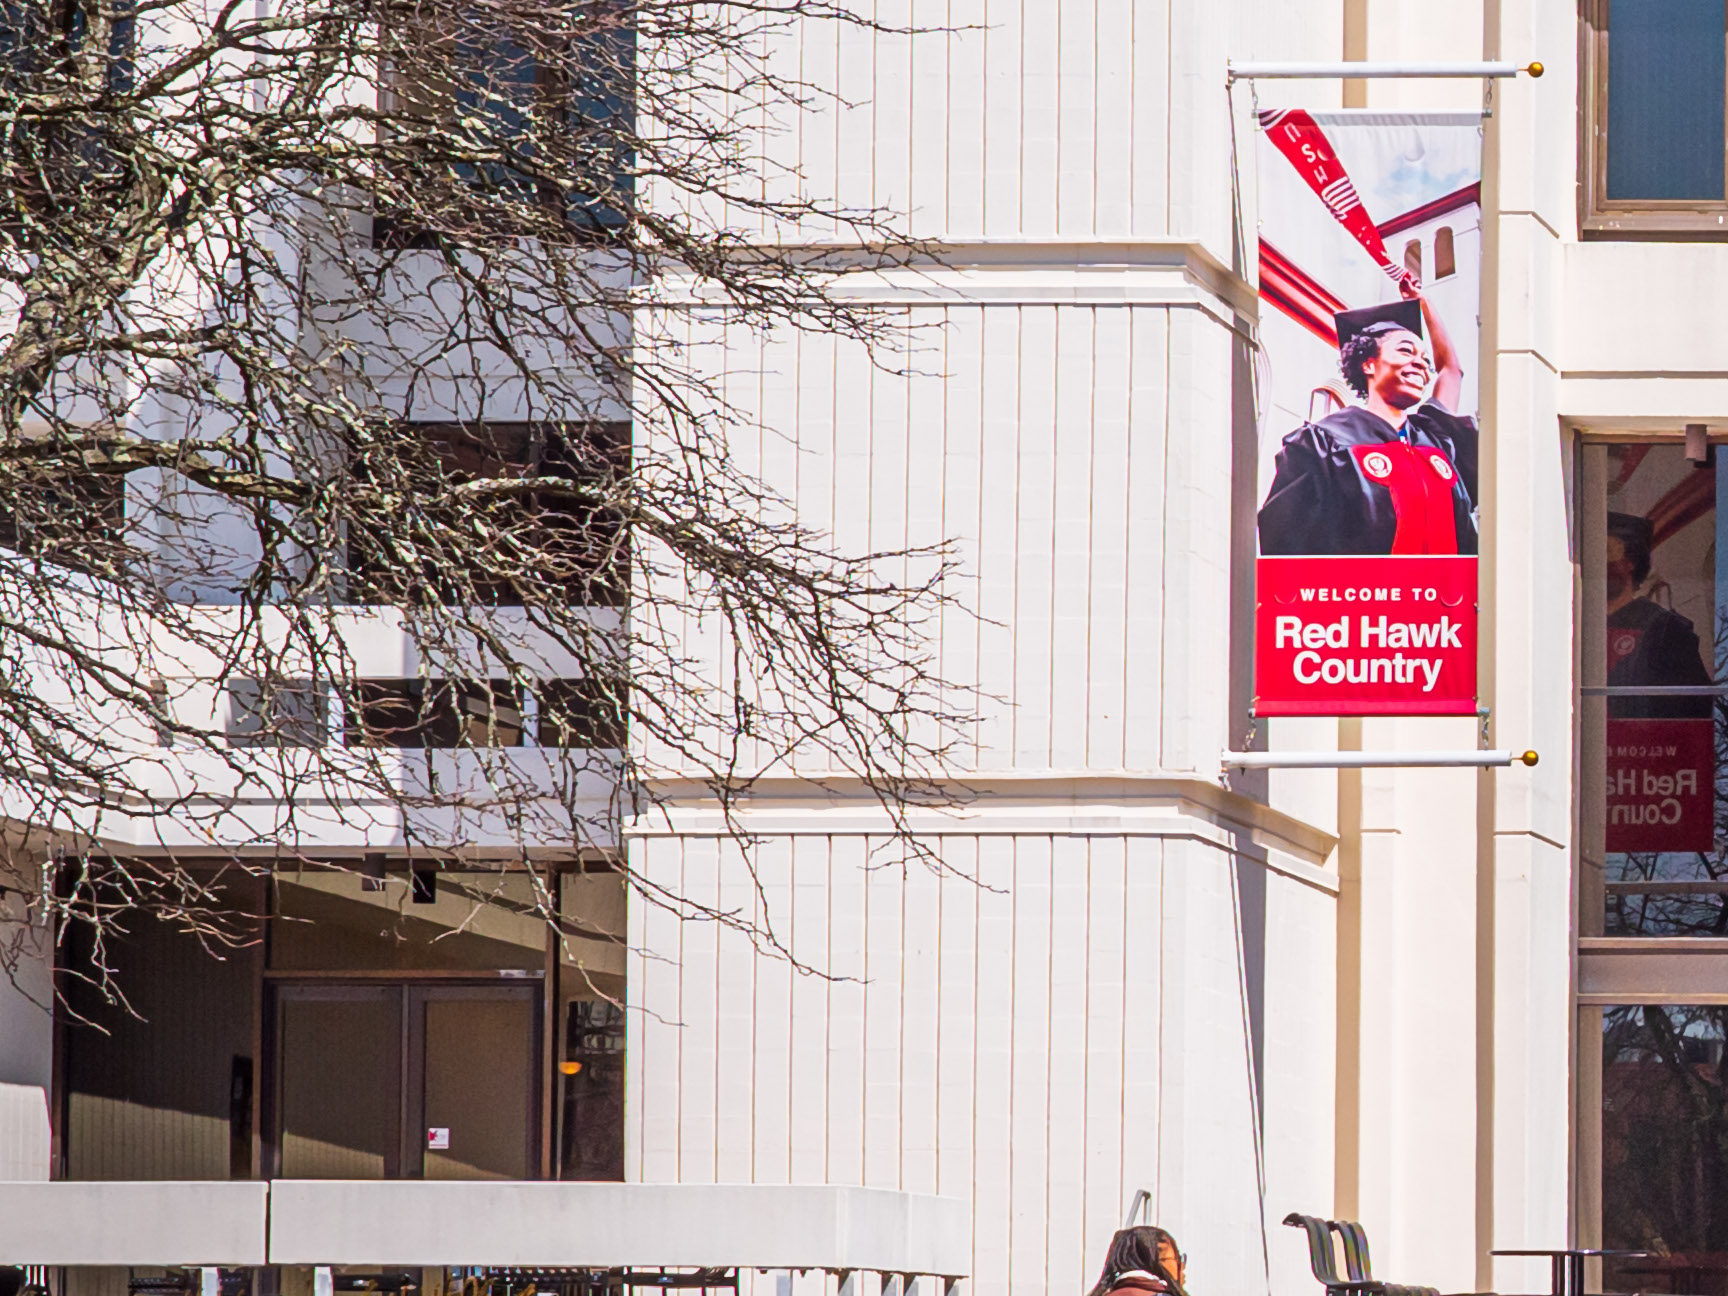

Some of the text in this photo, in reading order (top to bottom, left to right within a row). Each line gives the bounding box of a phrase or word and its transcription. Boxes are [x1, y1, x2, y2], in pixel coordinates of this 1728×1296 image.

[1300, 588, 1437, 601] WELCOME TO
[1275, 615, 1463, 649] Red Hawk
[1292, 650, 1443, 692] Country
